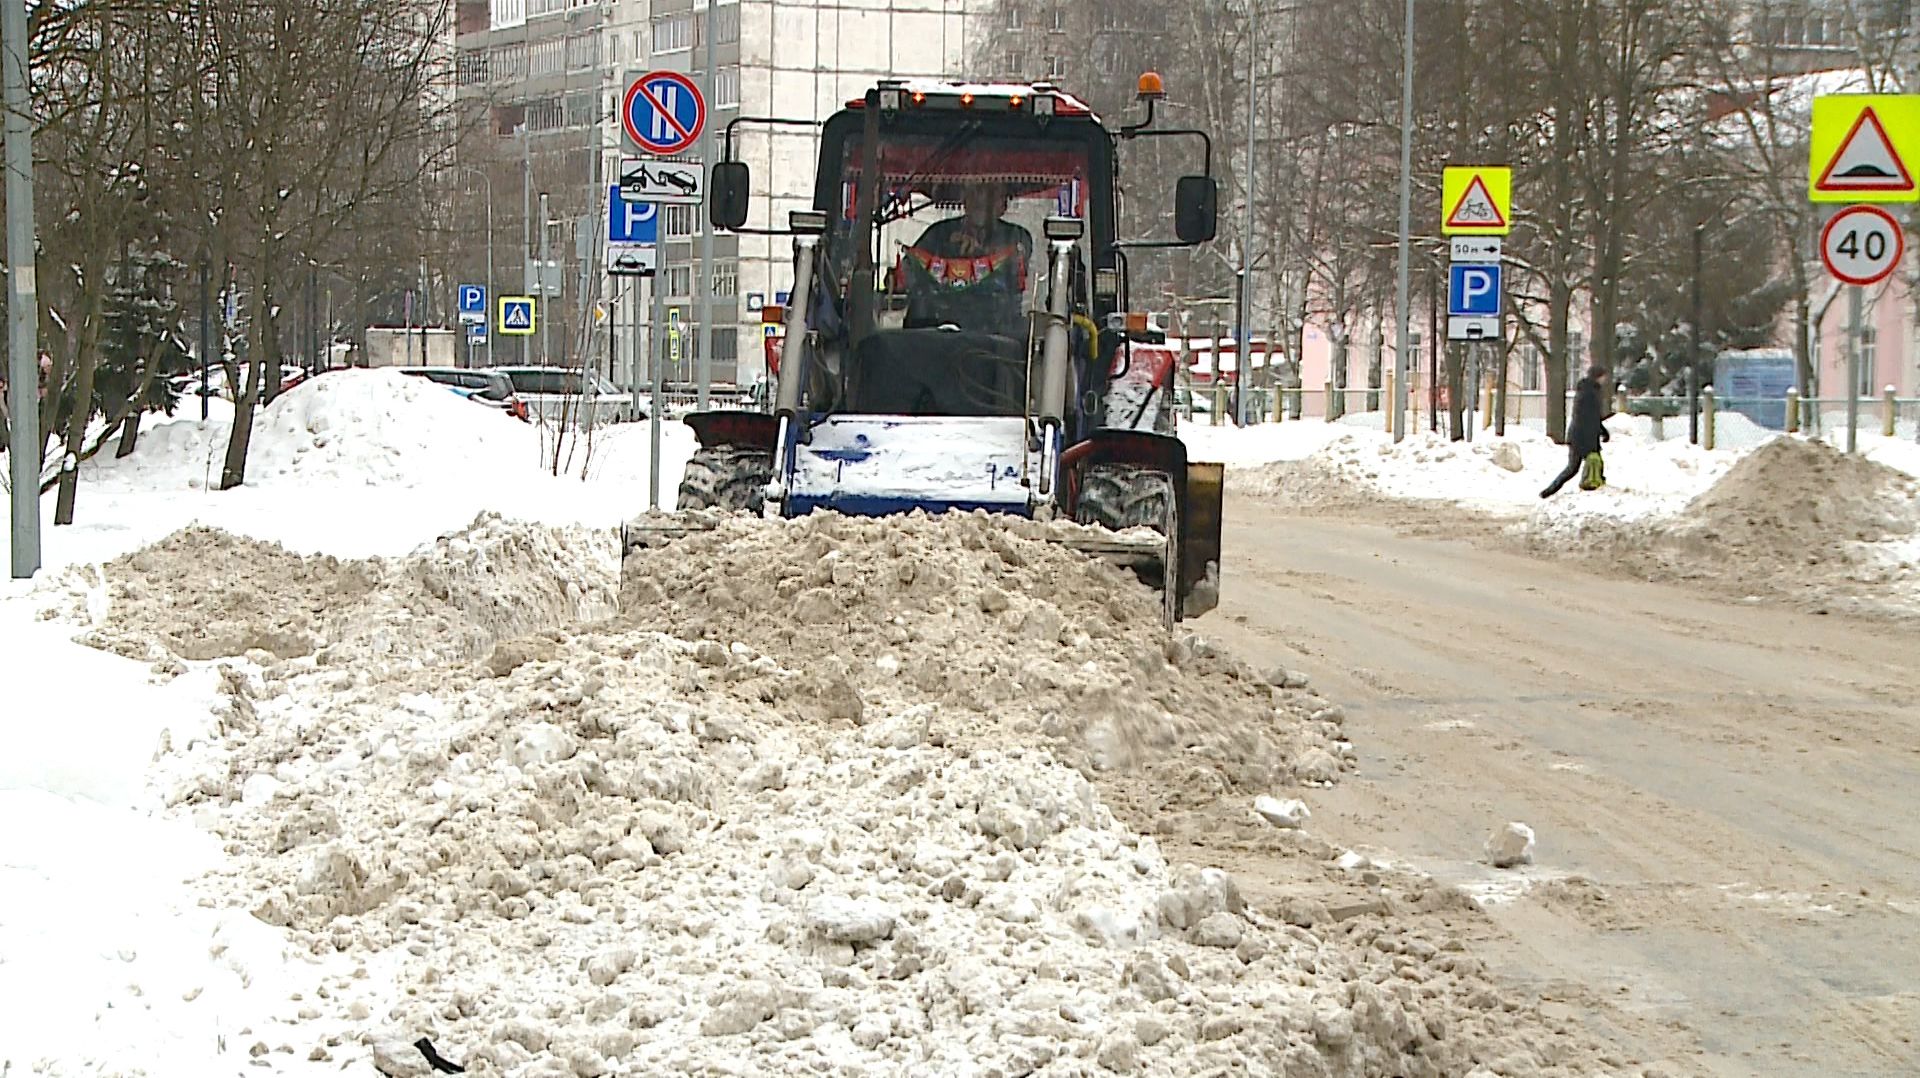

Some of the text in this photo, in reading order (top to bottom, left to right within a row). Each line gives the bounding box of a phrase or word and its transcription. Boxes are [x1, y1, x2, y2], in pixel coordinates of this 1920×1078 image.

[625, 202, 657, 236] P
[1455, 244, 1469, 253] 50
[1836, 230, 1885, 260] 40
[466, 288, 480, 309] P
[1462, 270, 1491, 309] P
